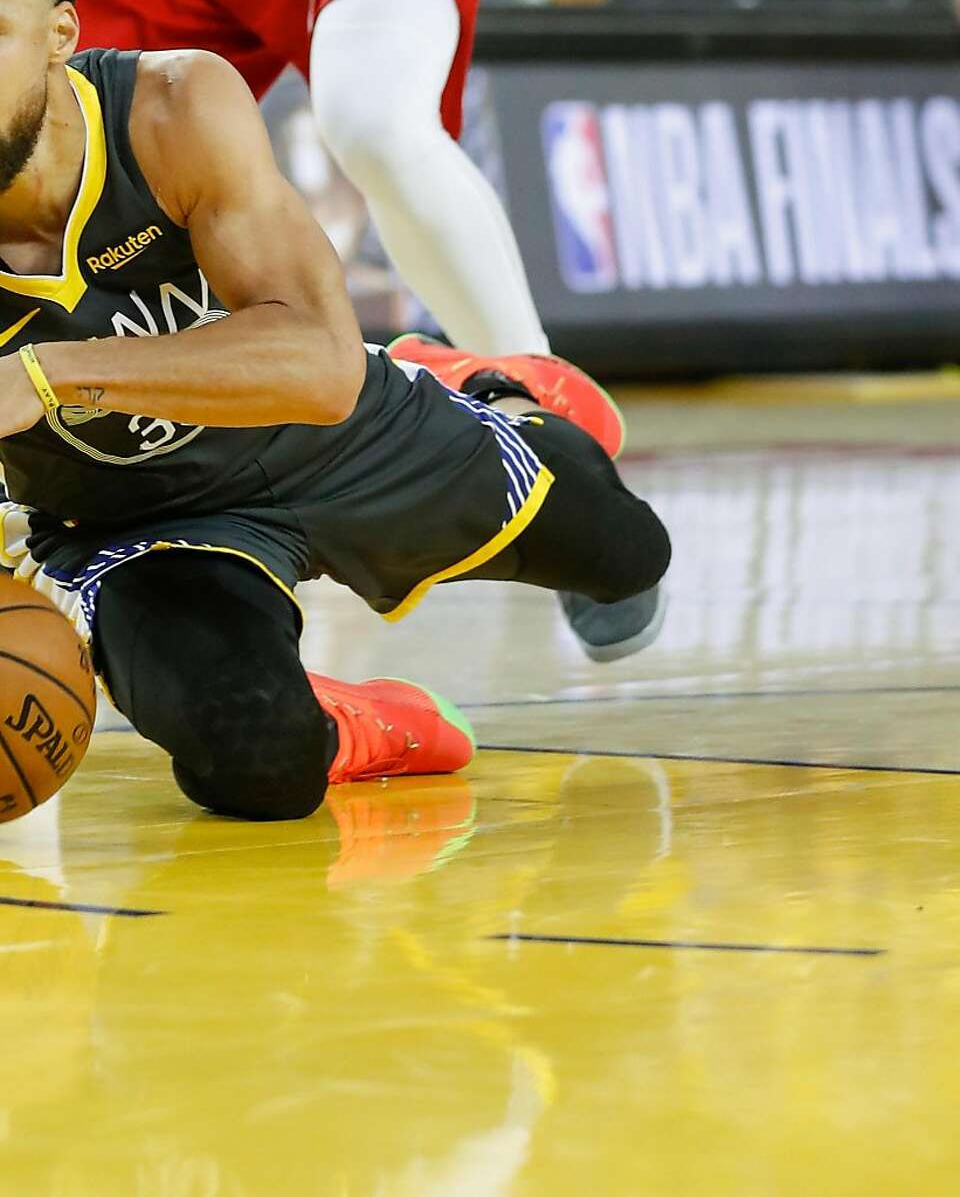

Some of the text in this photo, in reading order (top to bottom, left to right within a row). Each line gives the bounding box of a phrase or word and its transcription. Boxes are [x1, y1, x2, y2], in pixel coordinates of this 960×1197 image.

[603, 97, 960, 290] NBA FINALS
[86, 225, 163, 274] Rakuten
[128, 414, 177, 451] 3
